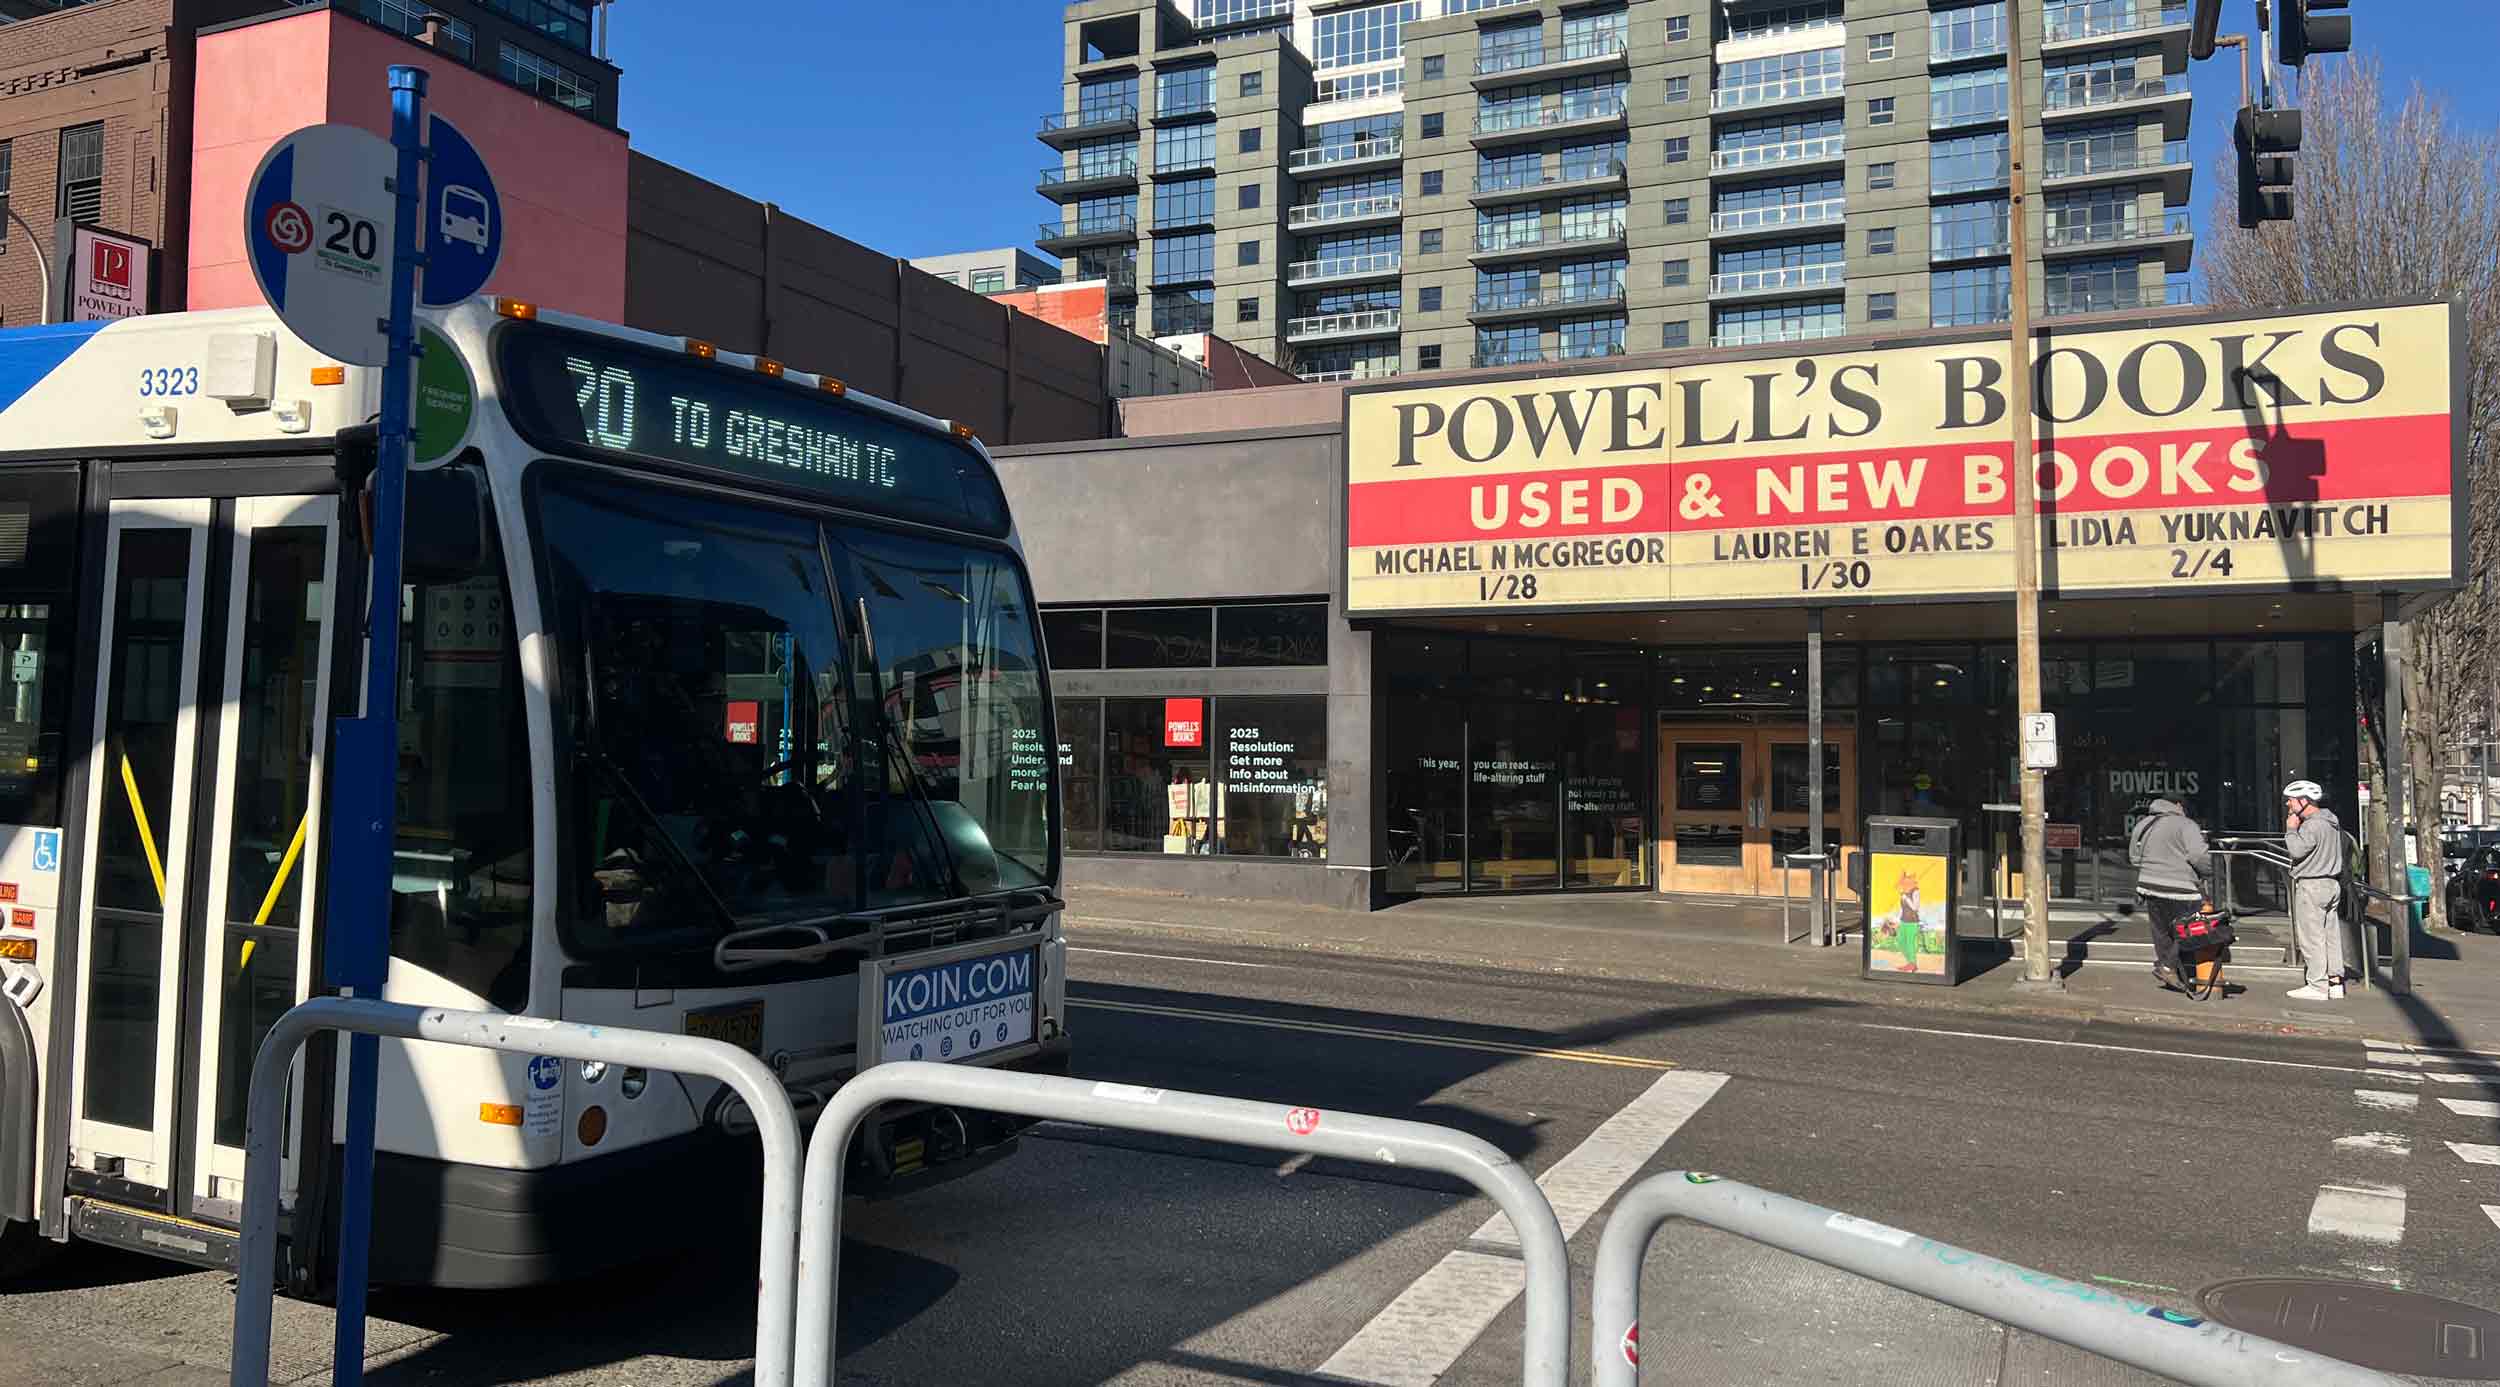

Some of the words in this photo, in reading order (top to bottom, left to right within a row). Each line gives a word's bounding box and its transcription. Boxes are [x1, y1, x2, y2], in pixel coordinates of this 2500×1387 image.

[326, 212, 377, 260] 20
[79, 295, 144, 318] POWELL'S
[140, 367, 198, 396] 3323
[1392, 359, 1882, 467] POWELL'S
[1935, 322, 2385, 430] BOOKS
[671, 396, 710, 448] TO
[726, 410, 858, 480] GRESHAM
[866, 443, 896, 487] TC
[1470, 477, 1644, 530] USED
[1679, 473, 1725, 521] &
[1756, 458, 1928, 515] NEW
[1963, 438, 2270, 505] BOOKS
[2048, 517, 2137, 547] LIDIA
[2160, 504, 2389, 544] YUKNAVITCH
[1714, 529, 1830, 561] LAUREN
[1852, 527, 1868, 555] E
[1885, 522, 1995, 553] OAKES
[1375, 545, 1481, 575] MICHAEL
[1491, 544, 1507, 570] N
[1515, 538, 1665, 568] MCGREGOR
[2171, 548, 2233, 578] 2/4
[1480, 574, 1537, 600] 1/28
[1801, 560, 1871, 590] 1/30
[1012, 729, 1037, 739] 2025
[1168, 721, 1199, 732] POWELL'S
[1173, 732, 1195, 742] BOOKS
[1230, 728, 1259, 739] 2025
[1230, 742, 1294, 752] Resolution:
[1011, 769, 1040, 777] more.
[1230, 756, 1250, 766] Get
[1253, 758, 1283, 766] more
[1417, 758, 1436, 768] This
[1438, 759, 1460, 771] year,
[1473, 761, 1490, 771] you
[1492, 761, 1507, 769] can
[1509, 759, 1529, 769] read
[1010, 780, 1034, 791] Fear
[1254, 769, 1288, 780] about
[1473, 772, 1524, 784] life-altering
[1526, 773, 1545, 783] stuff
[2110, 770, 2199, 794] POWELL'S
[886, 953, 1031, 1018] KOIN.COM
[882, 1015, 952, 1046] WATCHING
[955, 1008, 981, 1028] OUT
[983, 1001, 1007, 1020] FOR
[1009, 996, 1033, 1015] YOU
